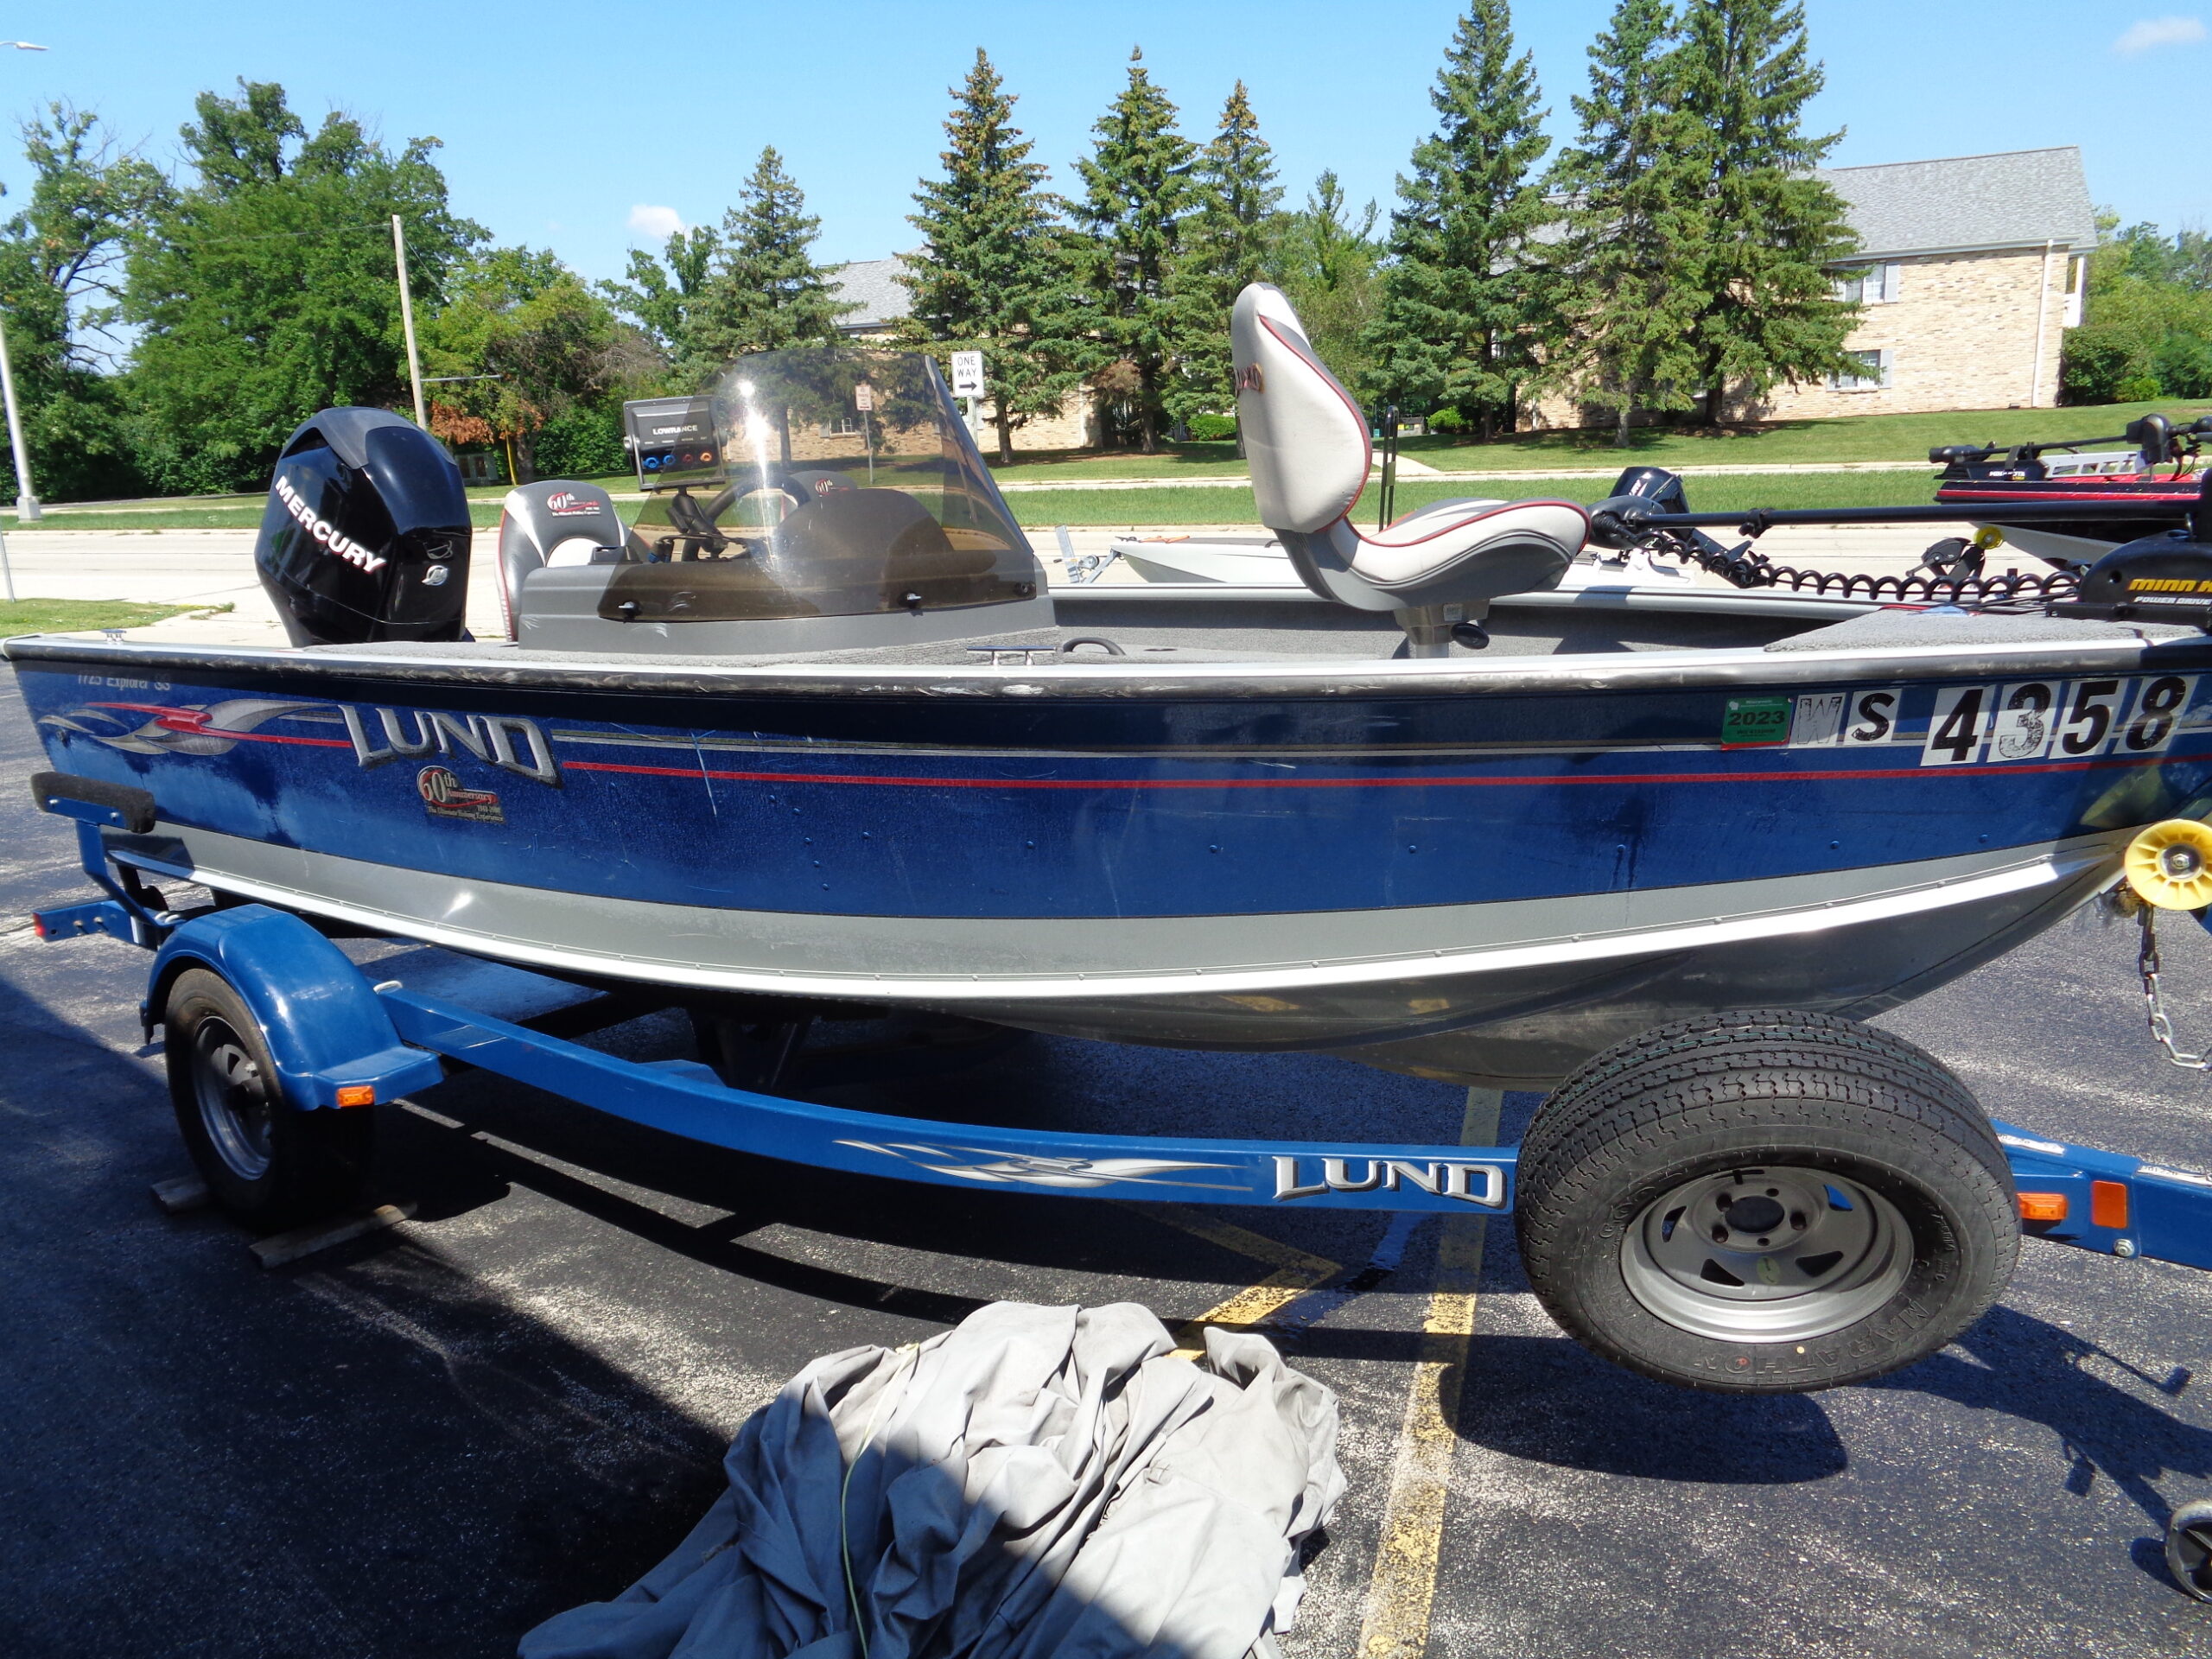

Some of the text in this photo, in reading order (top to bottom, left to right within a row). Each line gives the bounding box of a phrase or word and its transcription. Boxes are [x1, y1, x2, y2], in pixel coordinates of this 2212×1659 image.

[957, 355, 976, 366] ONE
[957, 367, 977, 378] WAY
[652, 425, 698, 435] LOWRANCE
[547, 493, 575, 511] 60th
[275, 476, 386, 575] MERCURY
[1728, 711, 1786, 726] 2023
[1931, 677, 2186, 761] 4358
[338, 703, 563, 788] LUND
[418, 769, 458, 802] 60th
[1270, 1155, 1509, 1210] LUND
